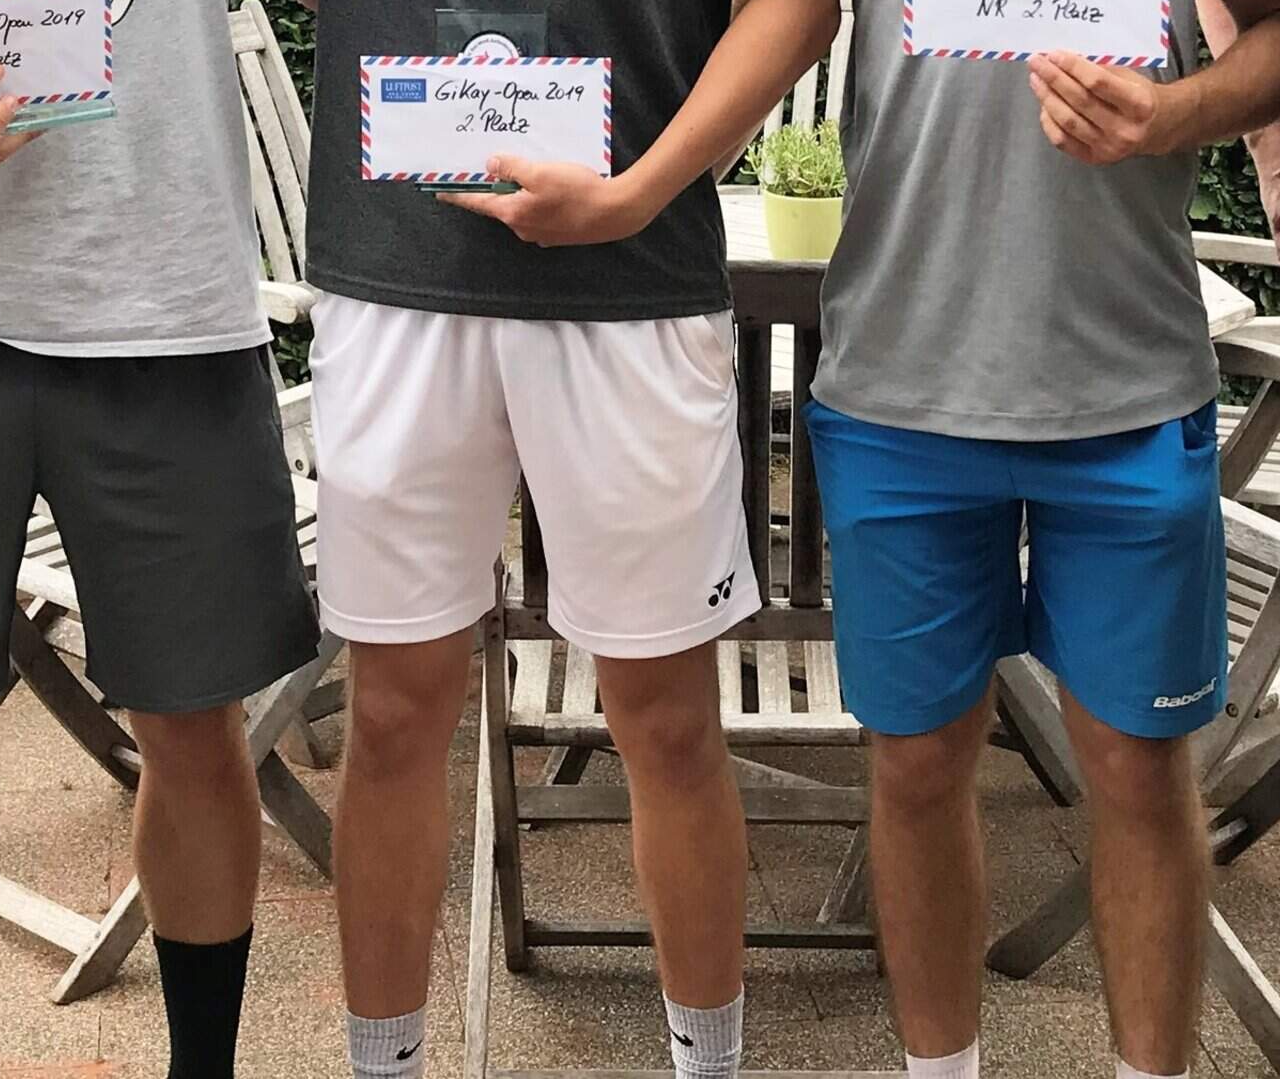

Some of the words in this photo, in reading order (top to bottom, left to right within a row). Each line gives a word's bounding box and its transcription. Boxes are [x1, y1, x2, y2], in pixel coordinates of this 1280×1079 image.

[40, 9, 85, 26] 2019
[1024, 0, 1044, 19] 2.
[545, 81, 585, 103] 2019
[456, 114, 474, 133] 2.
[480, 108, 530, 133] Platz
